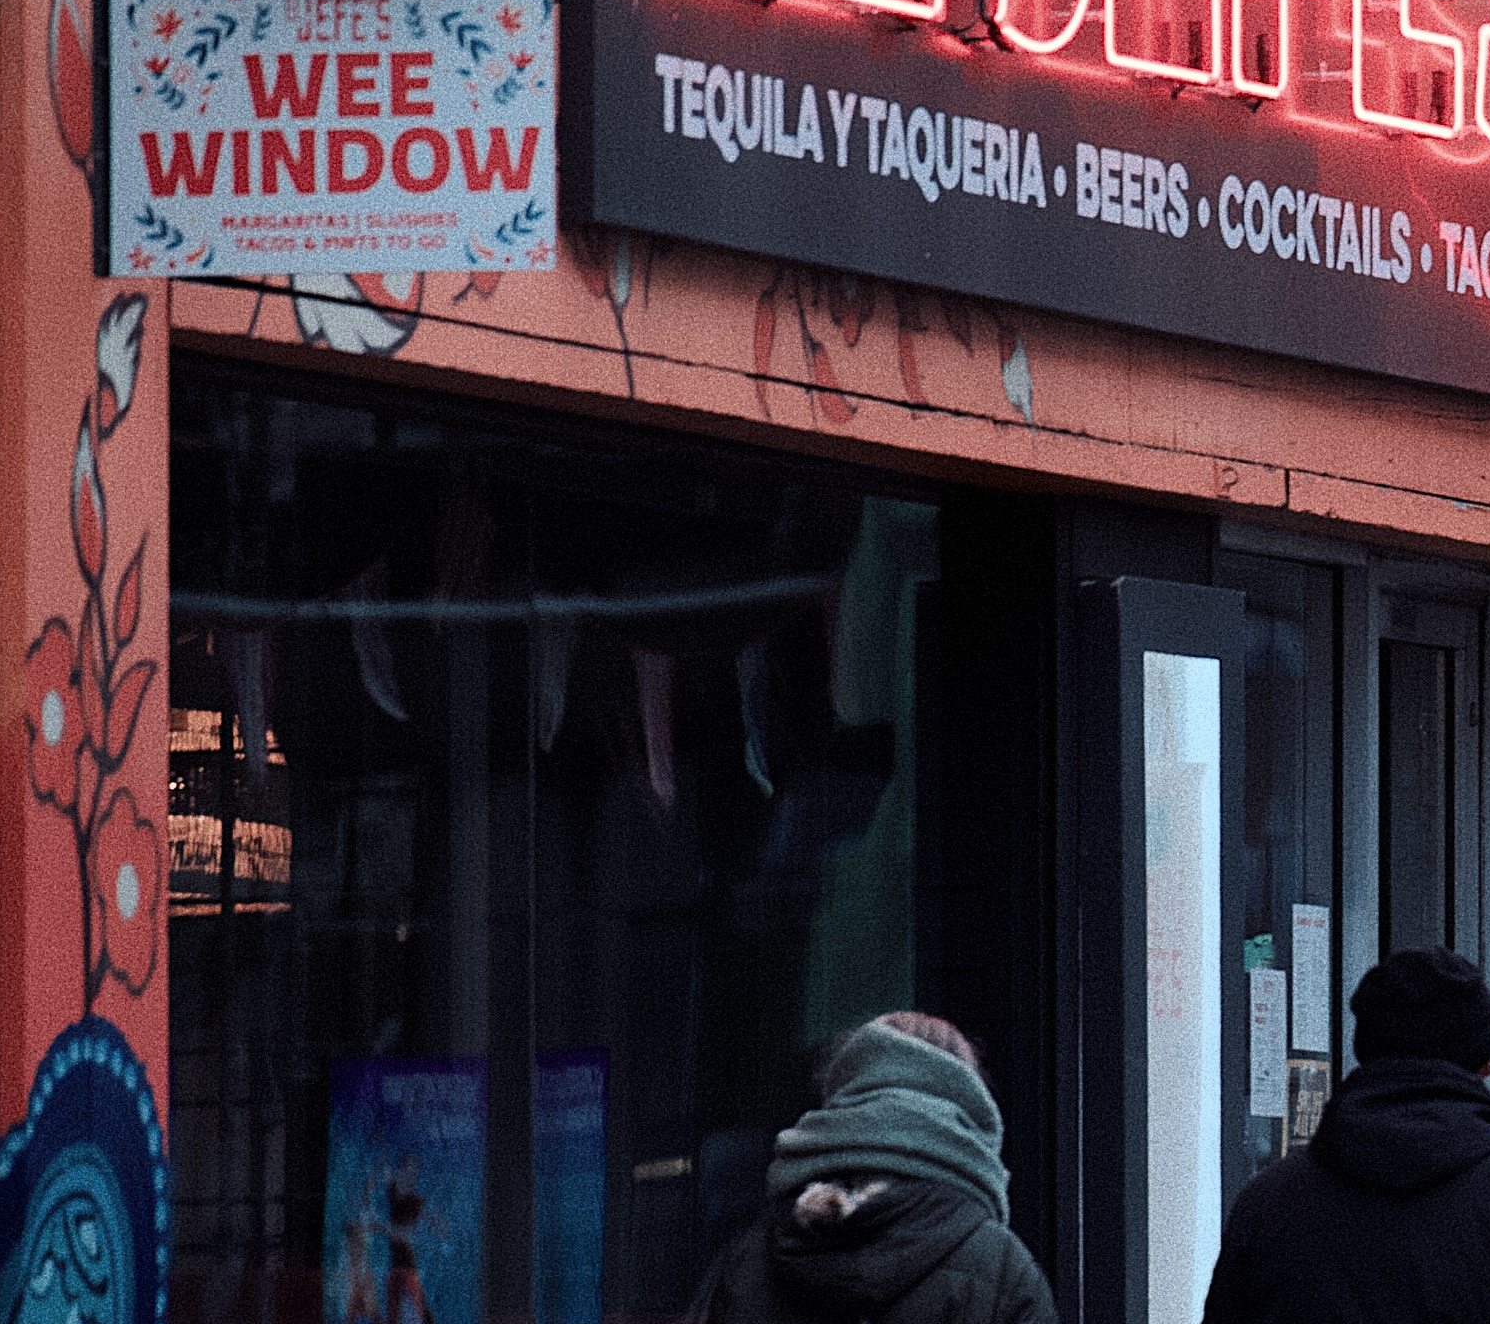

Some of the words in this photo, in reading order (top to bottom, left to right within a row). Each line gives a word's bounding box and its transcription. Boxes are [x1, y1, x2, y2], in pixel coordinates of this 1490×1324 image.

[242, 52, 434, 119] WEE
[138, 127, 541, 197] WINDOW
[655, 53, 824, 164] TEQUILA
[826, 88, 859, 169] Y
[858, 94, 1047, 209] TAQUERIA
[1076, 142, 1190, 238] BEERS
[1217, 175, 1411, 284] COCKTAILS
